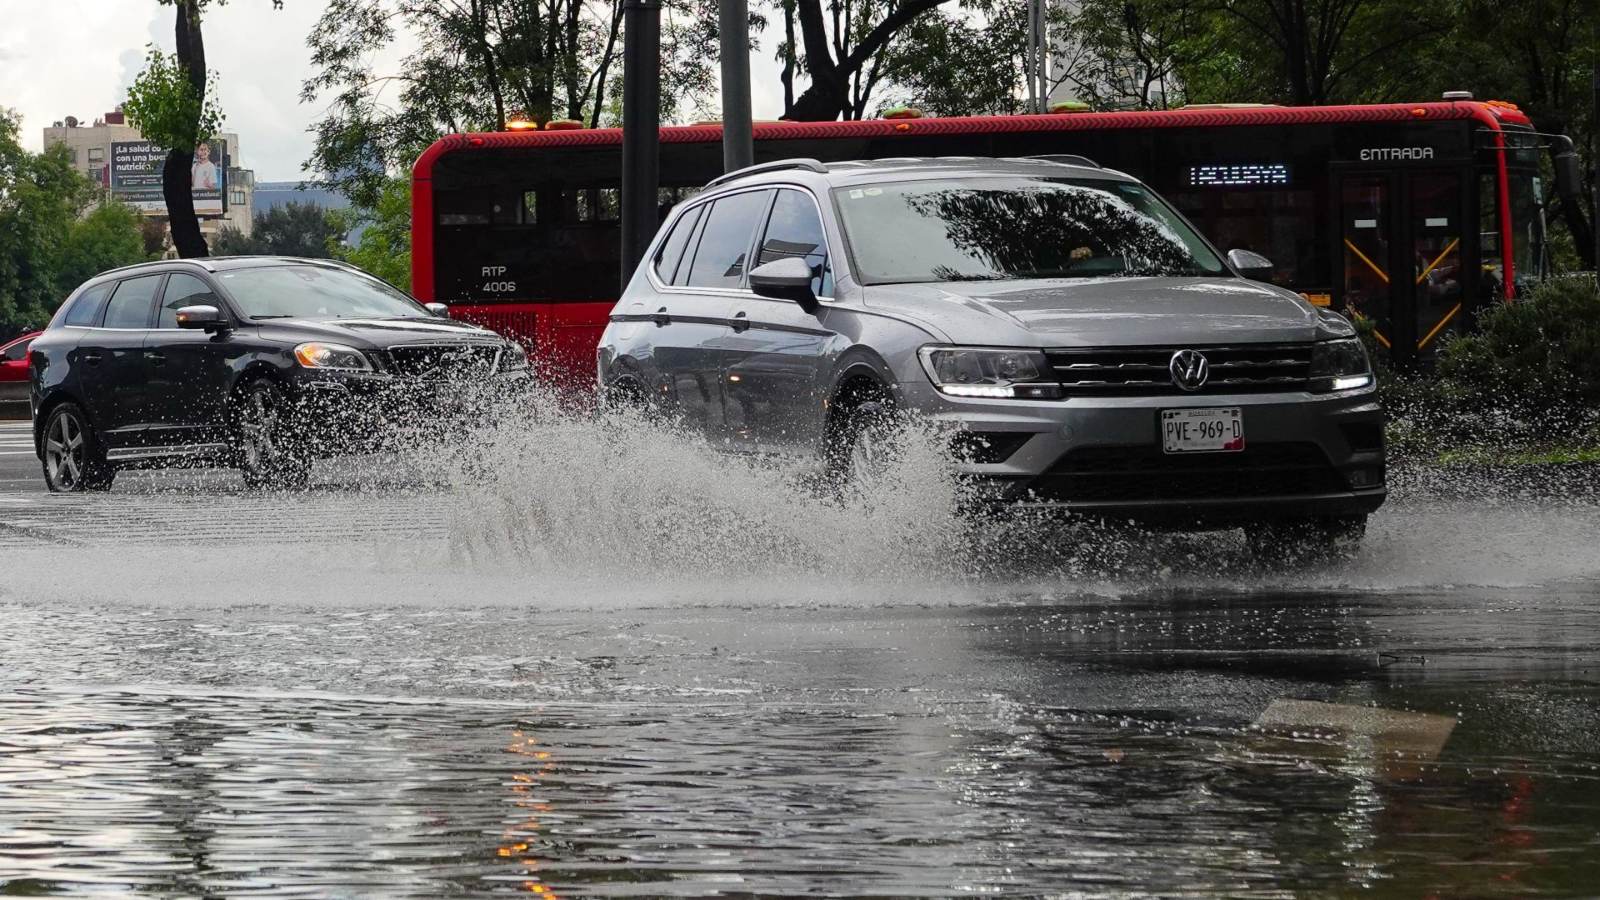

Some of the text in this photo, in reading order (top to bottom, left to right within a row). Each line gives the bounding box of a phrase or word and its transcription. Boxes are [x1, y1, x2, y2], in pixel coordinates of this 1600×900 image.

[129, 144, 151, 153] salud
[1359, 147, 1434, 161] ENTRADA
[148, 153, 166, 161] bue
[481, 266, 507, 277] RTP
[482, 281, 517, 292] 4006
[1165, 420, 1241, 441] PVE-969-D
